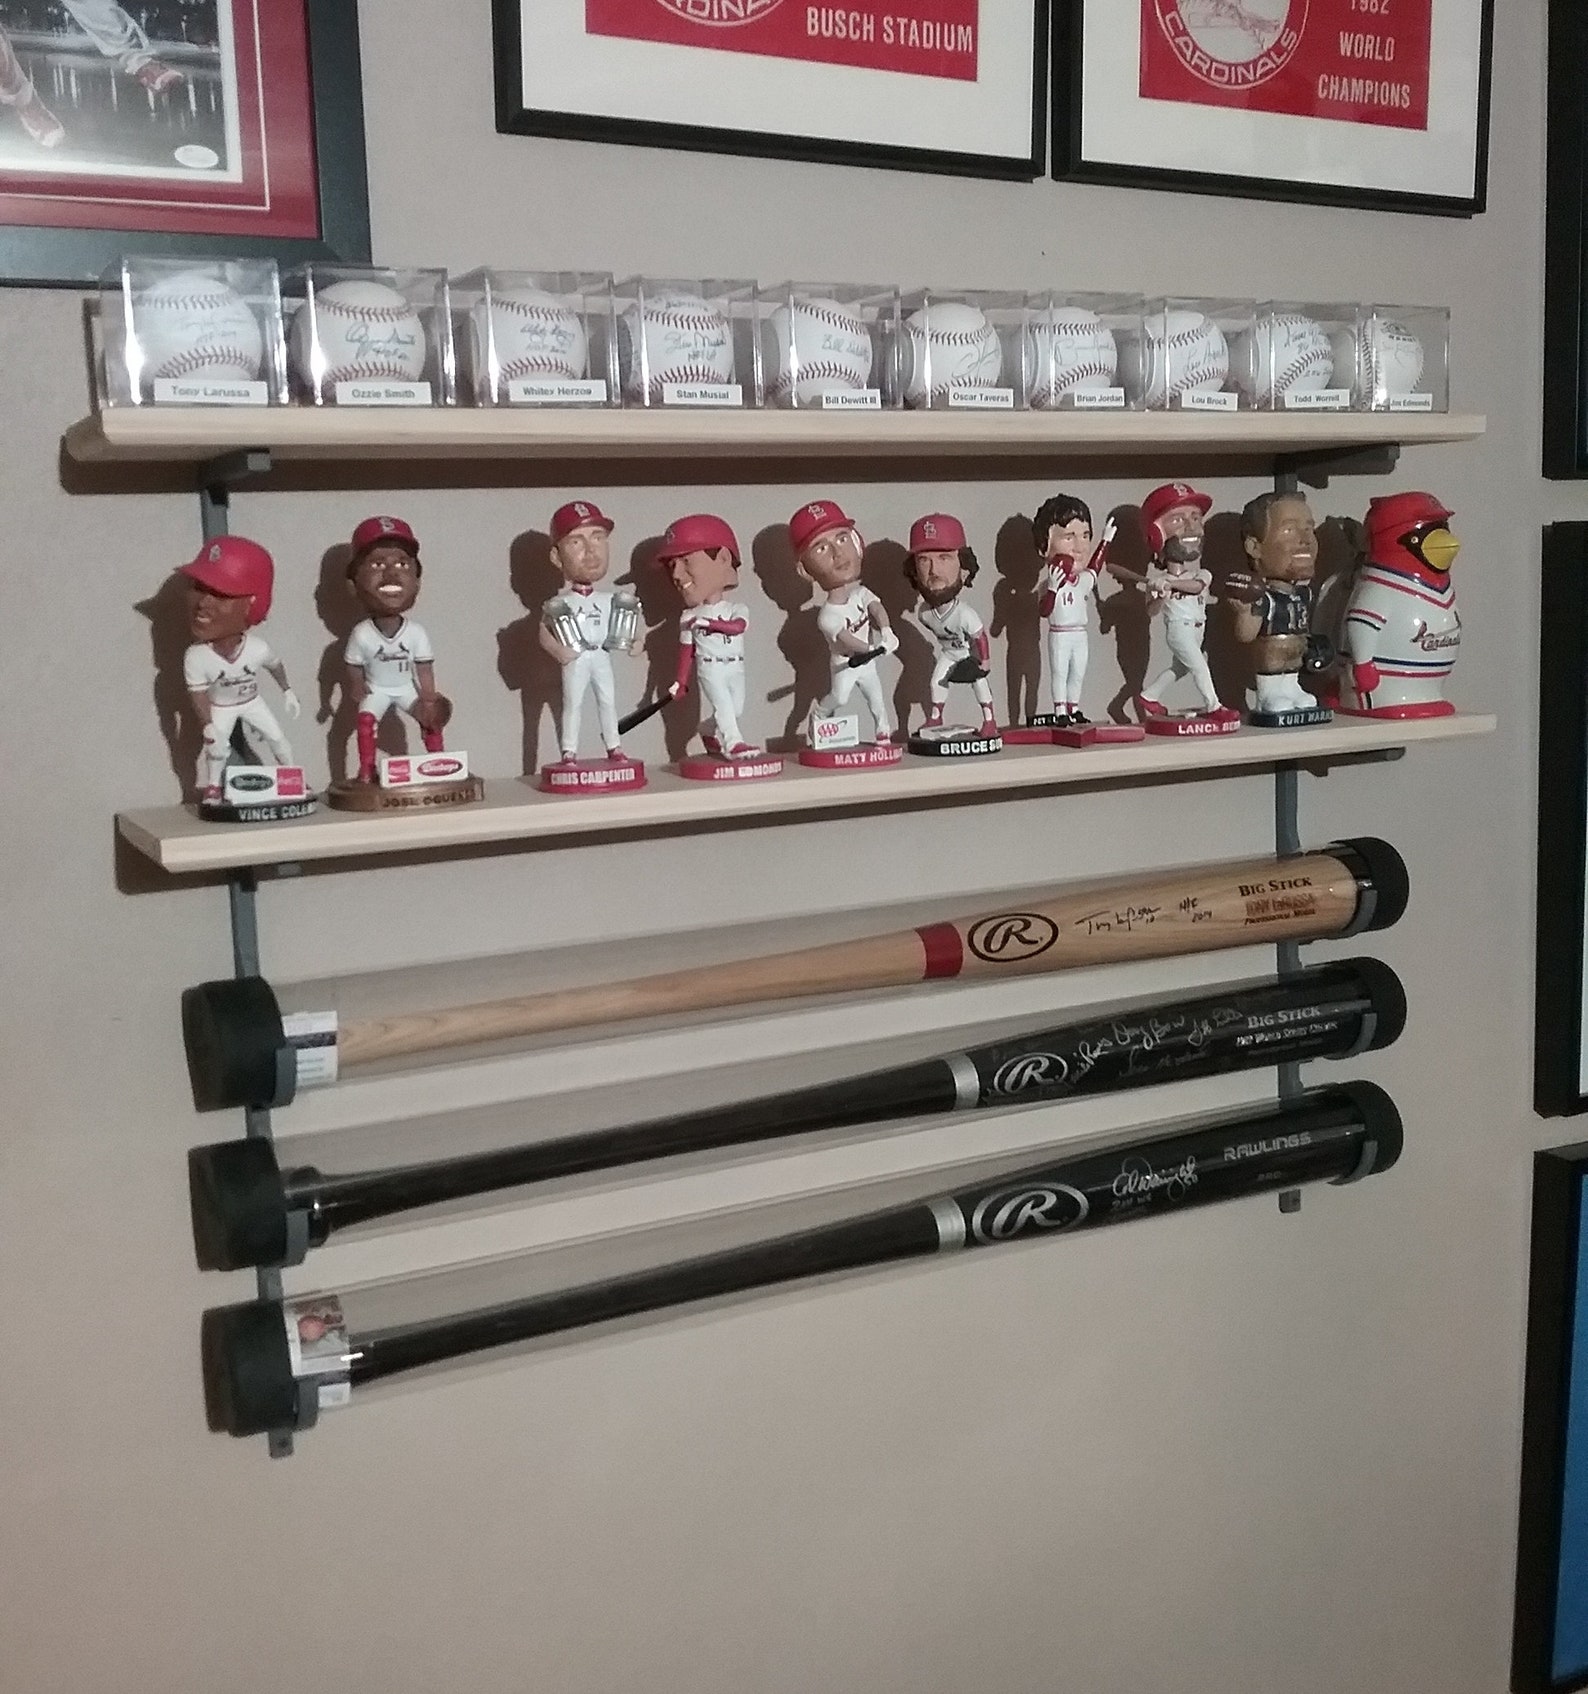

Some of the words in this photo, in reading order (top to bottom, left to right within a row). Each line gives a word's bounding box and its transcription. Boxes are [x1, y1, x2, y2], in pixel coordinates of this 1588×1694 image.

[806, 7, 874, 42] BUSCH
[882, 15, 974, 53] STADIUM
[1164, 11, 1298, 84] CARDINALS
[1338, 31, 1395, 62] WORLD
[1317, 73, 1411, 109] CHAMPIONS
[171, 386, 200, 397] Tony
[351, 388, 382, 399] Ozzie
[383, 388, 416, 399] Smith
[676, 390, 698, 399] Stan
[699, 390, 729, 400] Musial
[953, 392, 976, 401] Oscar
[978, 393, 1010, 403] Taveras
[1077, 394, 1097, 403] Brian
[1098, 394, 1123, 403] Jordan
[825, 395, 838, 405] Bill
[839, 396, 868, 405] Dewitt
[1191, 395, 1206, 405] Lou
[1207, 396, 1228, 406] Brock
[1294, 395, 1312, 403] Todd
[1061, 591, 1075, 605] 14
[1288, 603, 1308, 631] 13
[1278, 713, 1305, 727] KURT
[1178, 724, 1219, 736] LANCE
[940, 740, 988, 755] BRUCE
[834, 753, 867, 766] MATT
[550, 766, 578, 786] CHRIS
[579, 767, 636, 785] CARPENTER
[713, 766, 735, 780] JIM
[239, 806, 278, 821] VINCE
[1238, 884, 1266, 898] BIG
[1268, 877, 1313, 893] STICK
[1247, 1014, 1276, 1030] BIG
[1277, 1006, 1322, 1024] STICK
[1223, 1131, 1313, 1162] RAWLINGS
